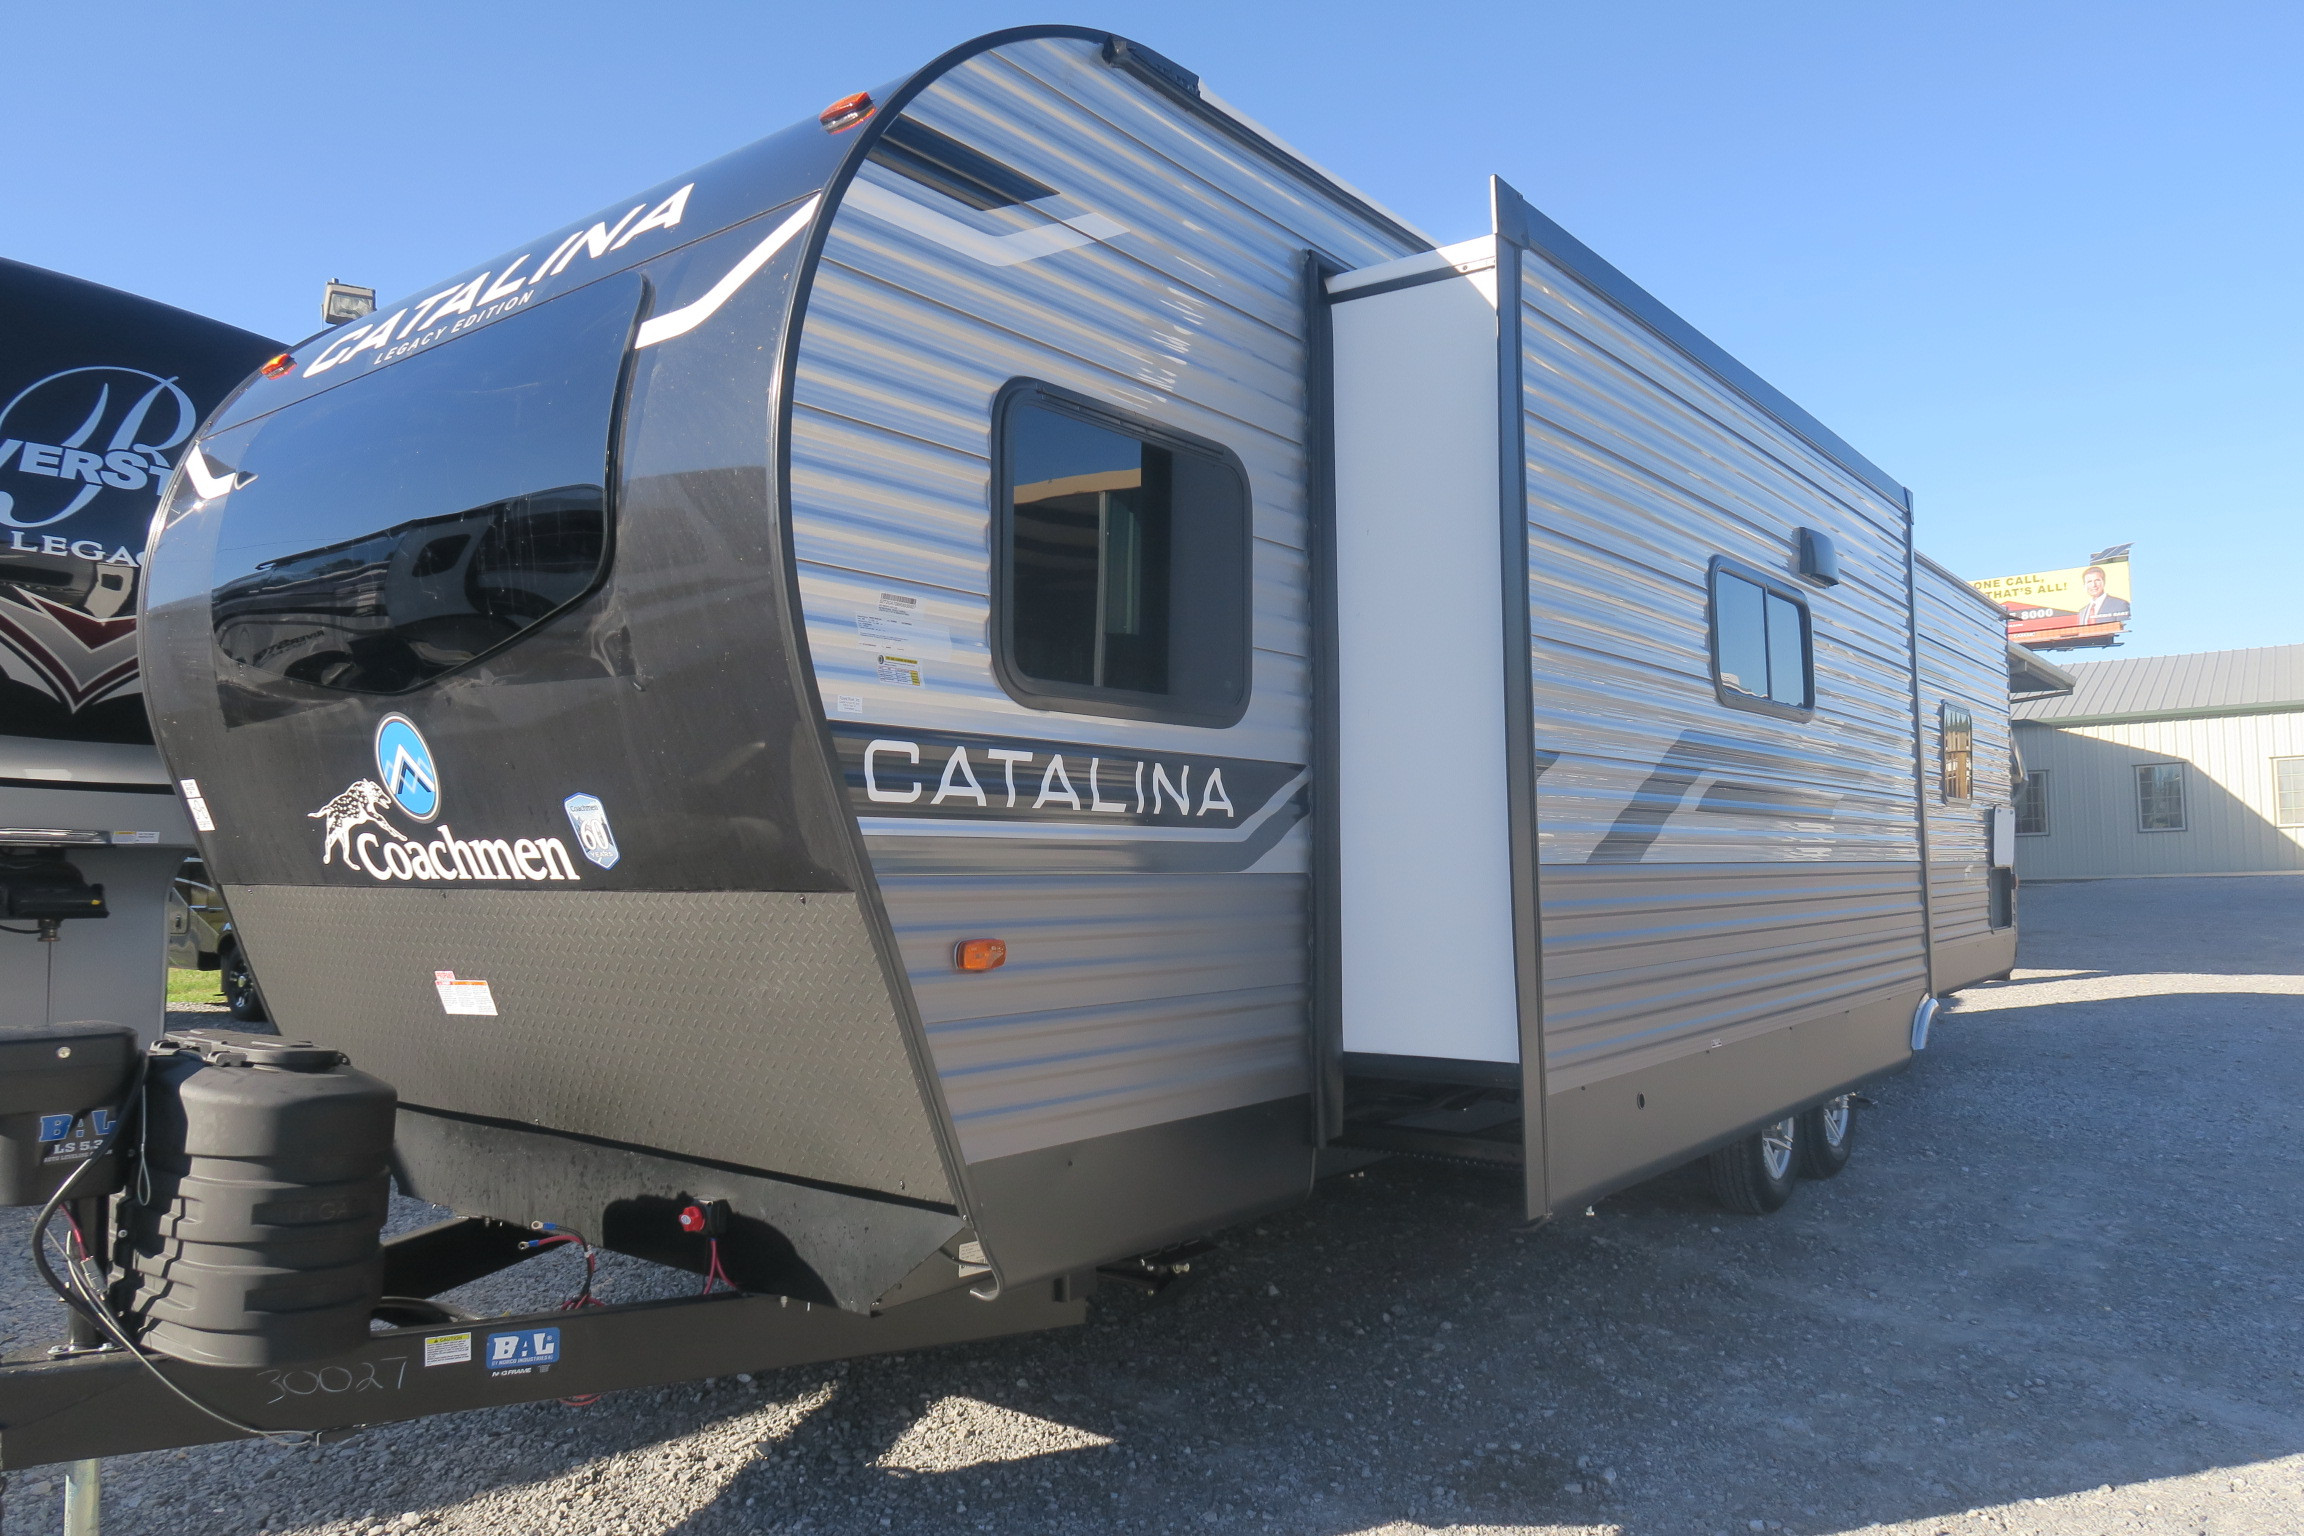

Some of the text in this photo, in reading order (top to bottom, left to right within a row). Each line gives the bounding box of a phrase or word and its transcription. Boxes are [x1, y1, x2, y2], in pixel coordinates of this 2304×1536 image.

[302, 182, 695, 379] CATALINA
[373, 288, 535, 366] LEGACY EDITION
[1973, 574, 2045, 591] ONE CALL,
[1985, 582, 2068, 599] THAT'S ALL!
[863, 738, 1235, 818] CATALINA
[580, 819, 609, 851] 60
[356, 824, 581, 881] Coachmen
[38, 1109, 117, 1142] BAL
[53, 1142, 76, 1155] LS
[491, 1332, 555, 1361] BAL
[257, 1356, 410, 1404] 30027
